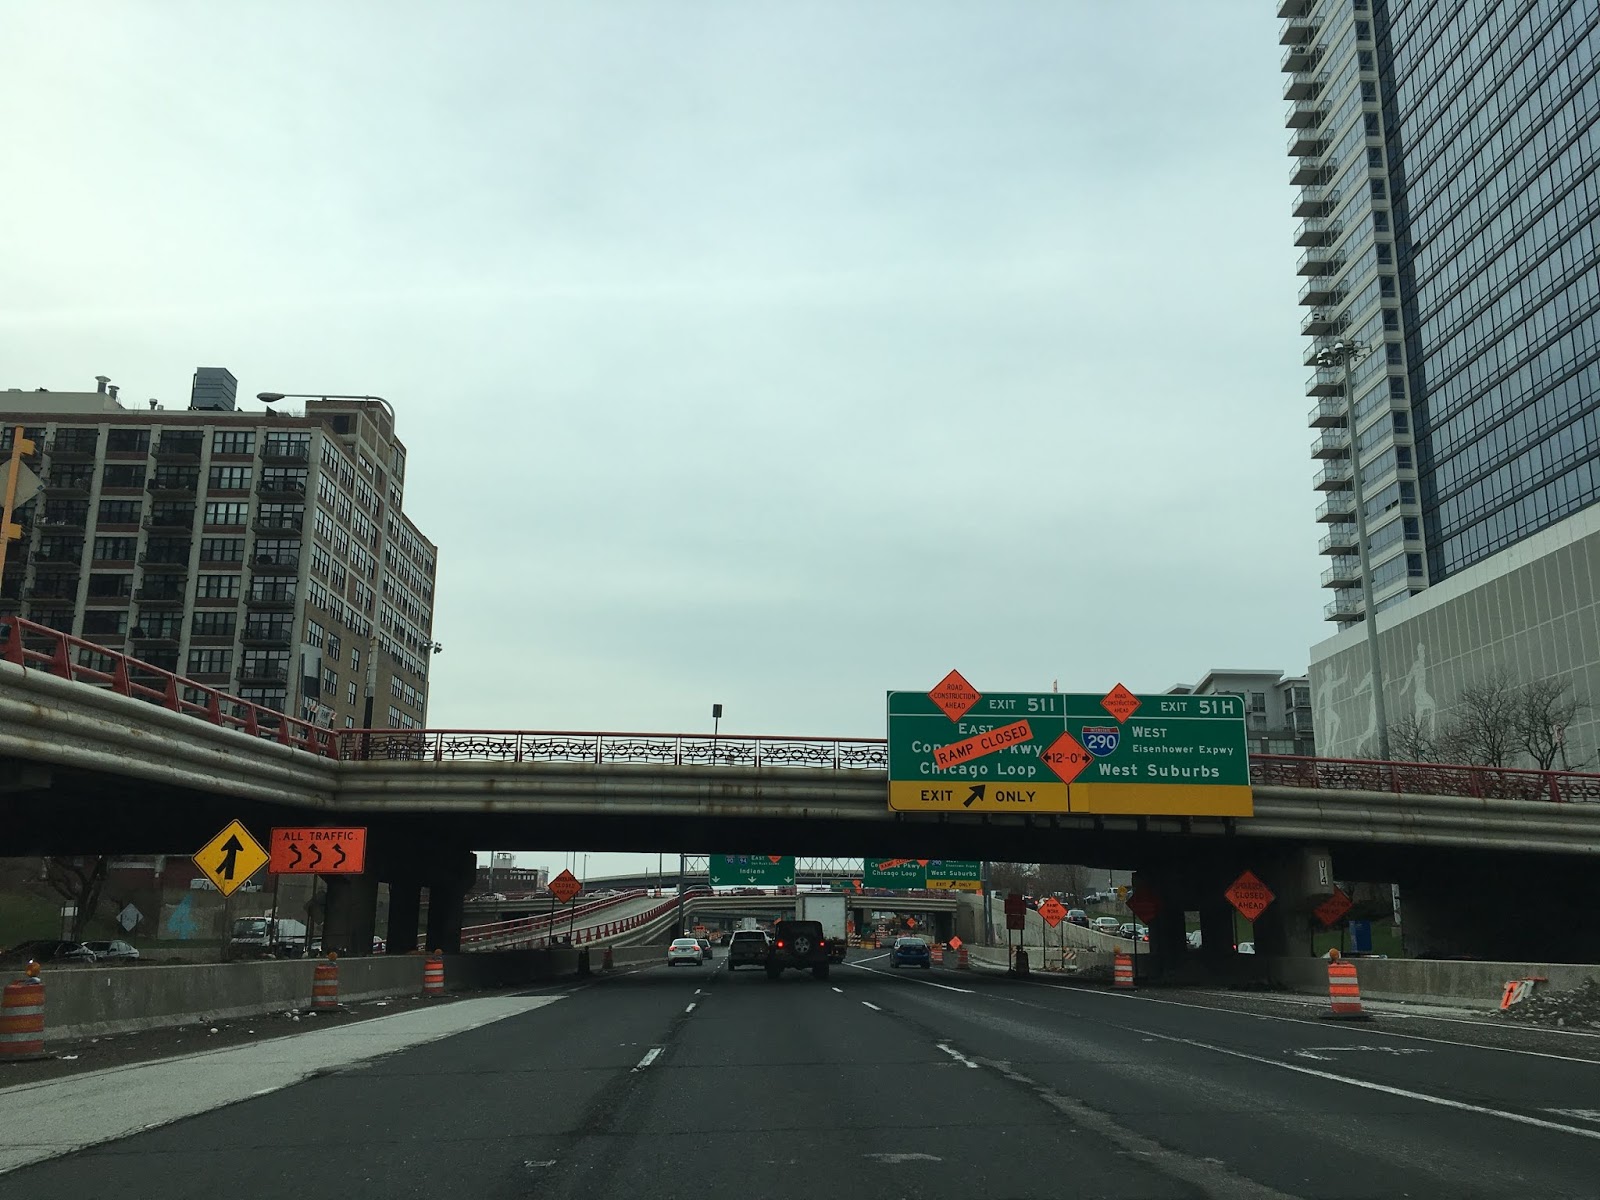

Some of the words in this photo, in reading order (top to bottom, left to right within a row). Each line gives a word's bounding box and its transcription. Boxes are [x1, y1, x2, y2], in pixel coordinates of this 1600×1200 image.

[989, 699, 1016, 710] EXIT
[1160, 702, 1188, 712] EXIT
[1199, 701, 1234, 714] 51H
[958, 723, 994, 735] EAST
[1132, 726, 1168, 738] WEST
[938, 744, 973, 764] RAMP
[980, 725, 1027, 750] CLOSED
[1087, 734, 1116, 749] 290
[1132, 744, 1193, 753] Eisenhower
[1199, 745, 1234, 756] Expwy
[997, 762, 1036, 778] Loop
[1099, 763, 1138, 776] West
[1147, 764, 1220, 777] Suburbs
[920, 790, 953, 801] EXIT
[995, 791, 1036, 802] ONLY
[283, 831, 304, 841] ALL
[309, 831, 354, 841] TRAFFIC
[1235, 891, 1264, 900] CLOSED
[1238, 901, 1264, 910] AHEAD
